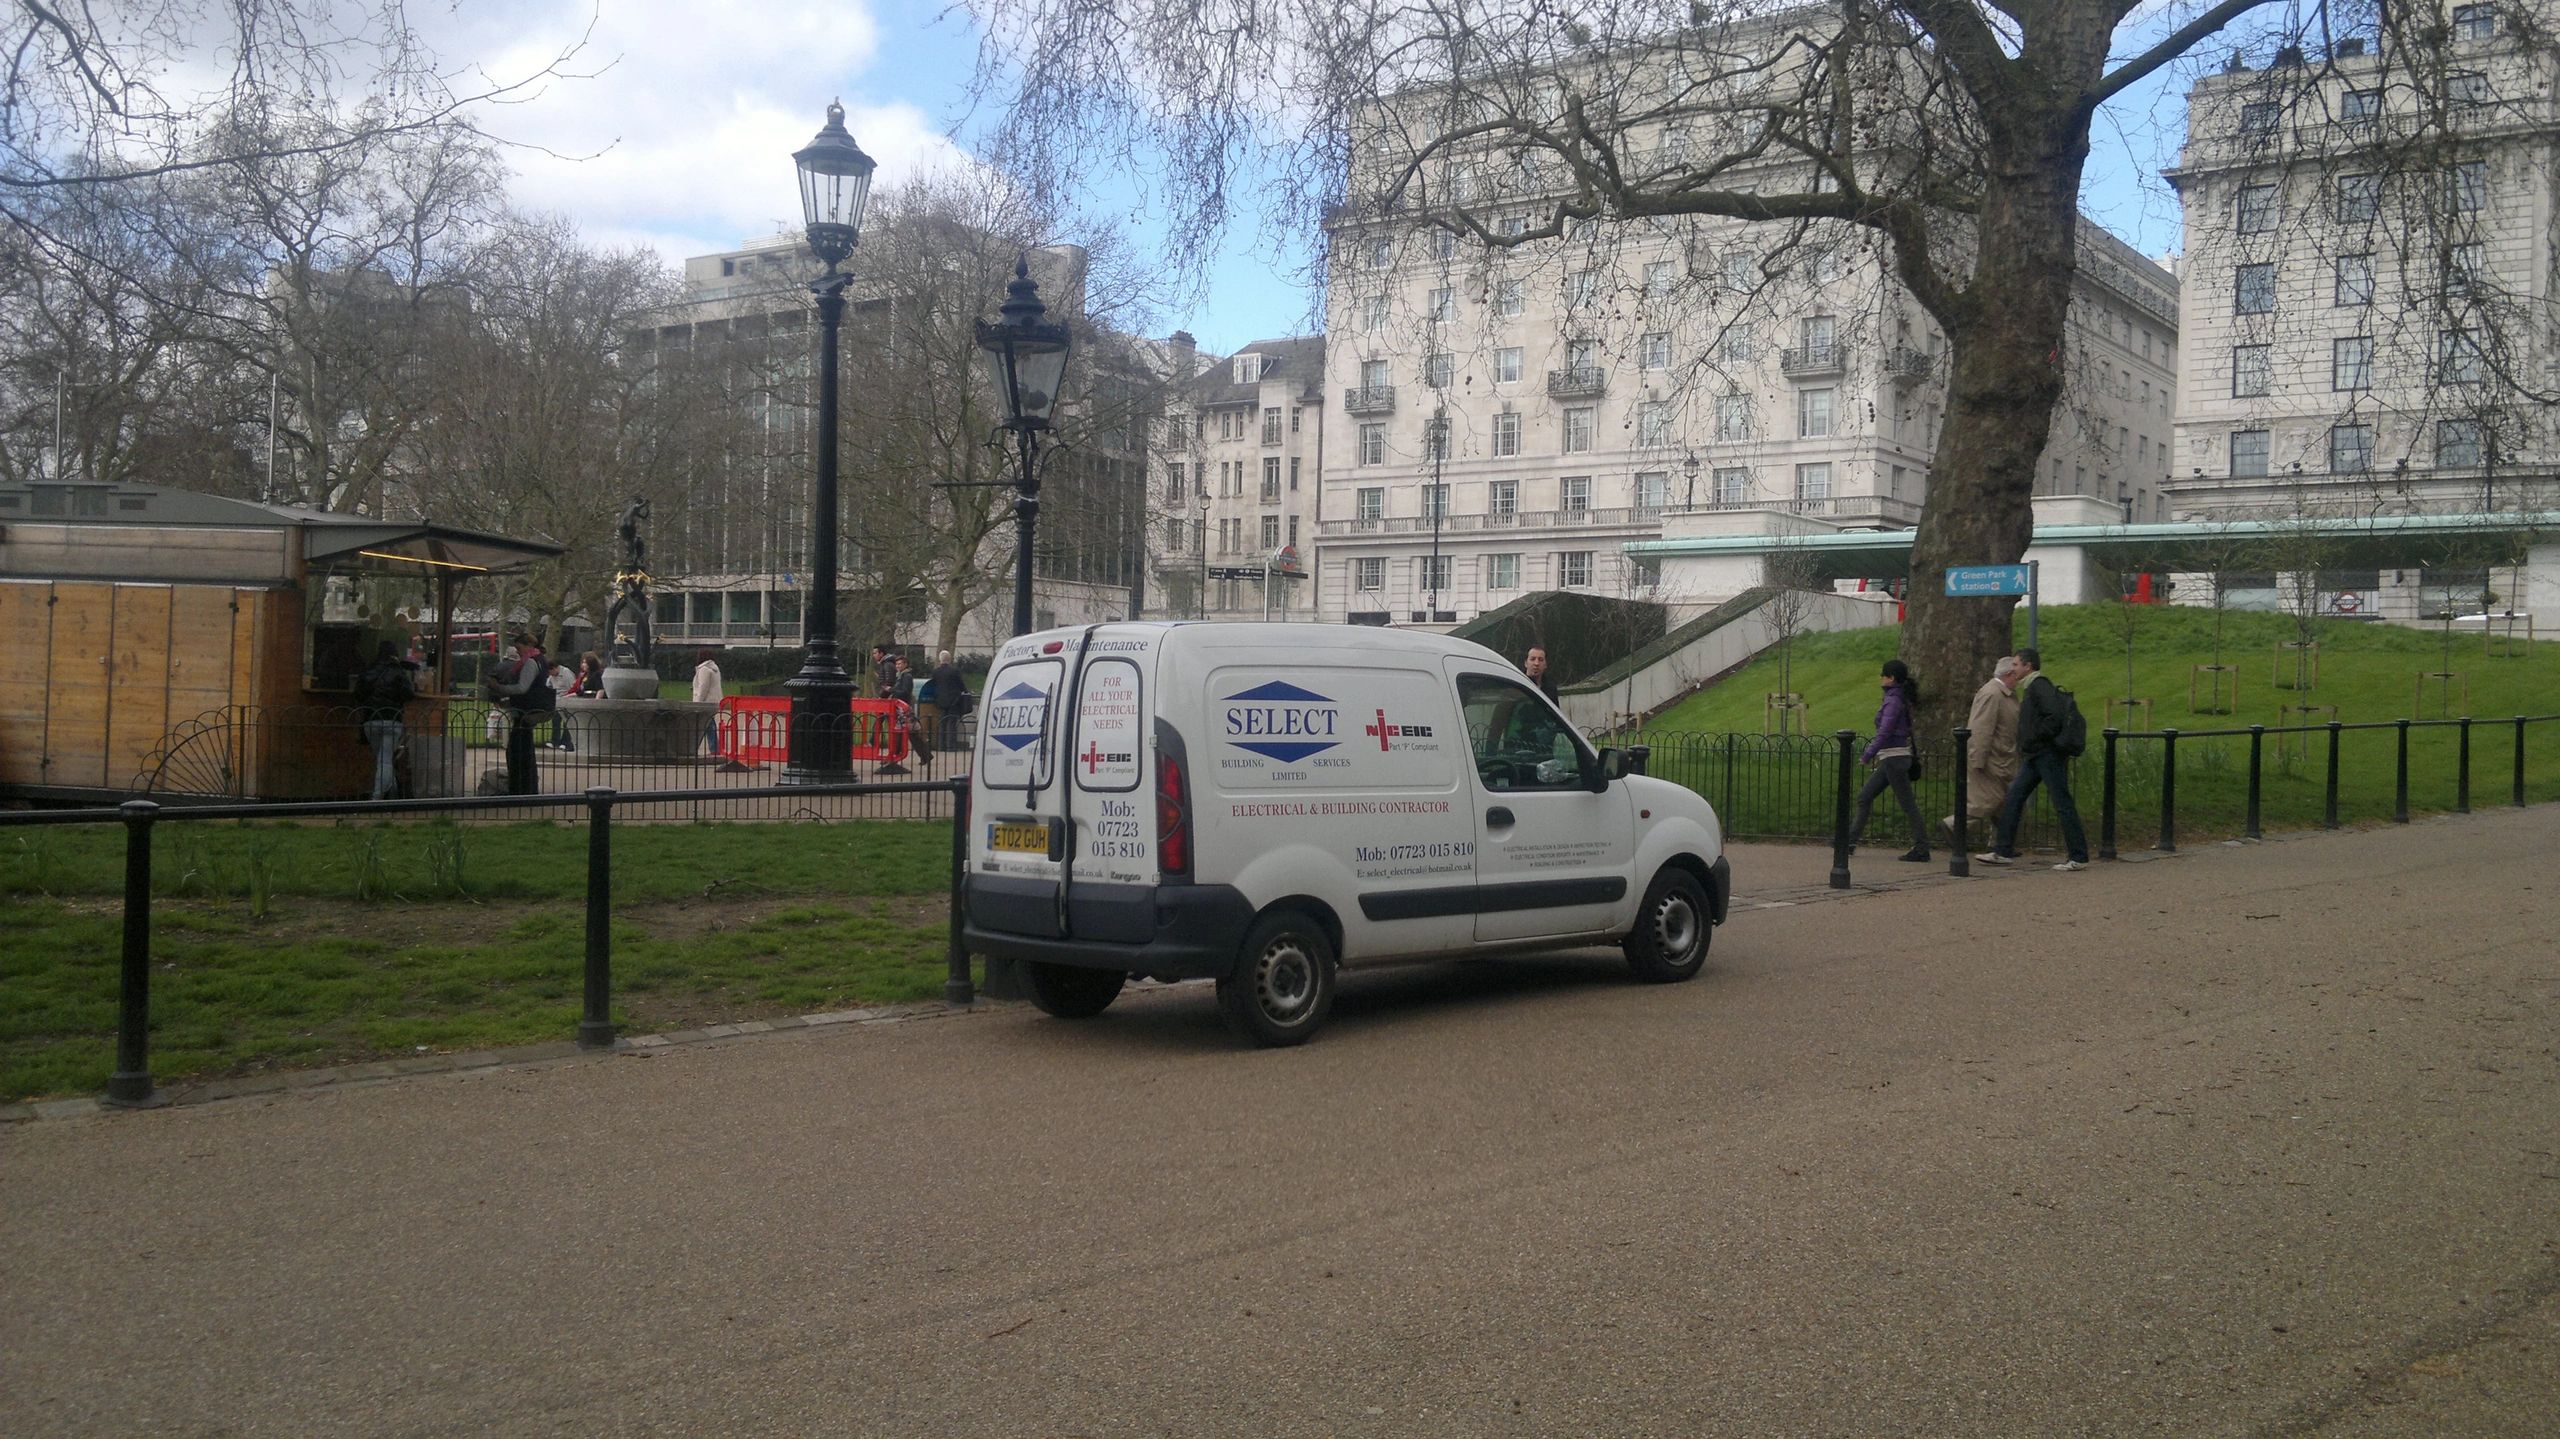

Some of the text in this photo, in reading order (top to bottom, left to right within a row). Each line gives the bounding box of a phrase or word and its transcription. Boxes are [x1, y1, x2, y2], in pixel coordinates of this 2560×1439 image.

[1988, 570, 2007, 578] Park
[1003, 644, 1036, 658] Factory
[1103, 676, 1122, 687] FOR
[1088, 690, 1133, 702] ALL YOUR
[1082, 704, 1138, 716] ELECTRICAL
[1093, 719, 1124, 730] NEEDS
[1226, 707, 1339, 736] SELECT
[1411, 742, 1439, 752] Compliant
[1221, 758, 1352, 769] BUILDING SERVICES
[1271, 771, 1307, 781] LIMITED
[1101, 800, 1136, 818] Mob:
[1231, 800, 1450, 817] ELECTRICAL & BUILDING CONTRACTOR
[1097, 821, 1139, 838] 07723
[1091, 841, 1145, 858] 015 810
[1355, 841, 1474, 862] Mob: 07723 015 810
